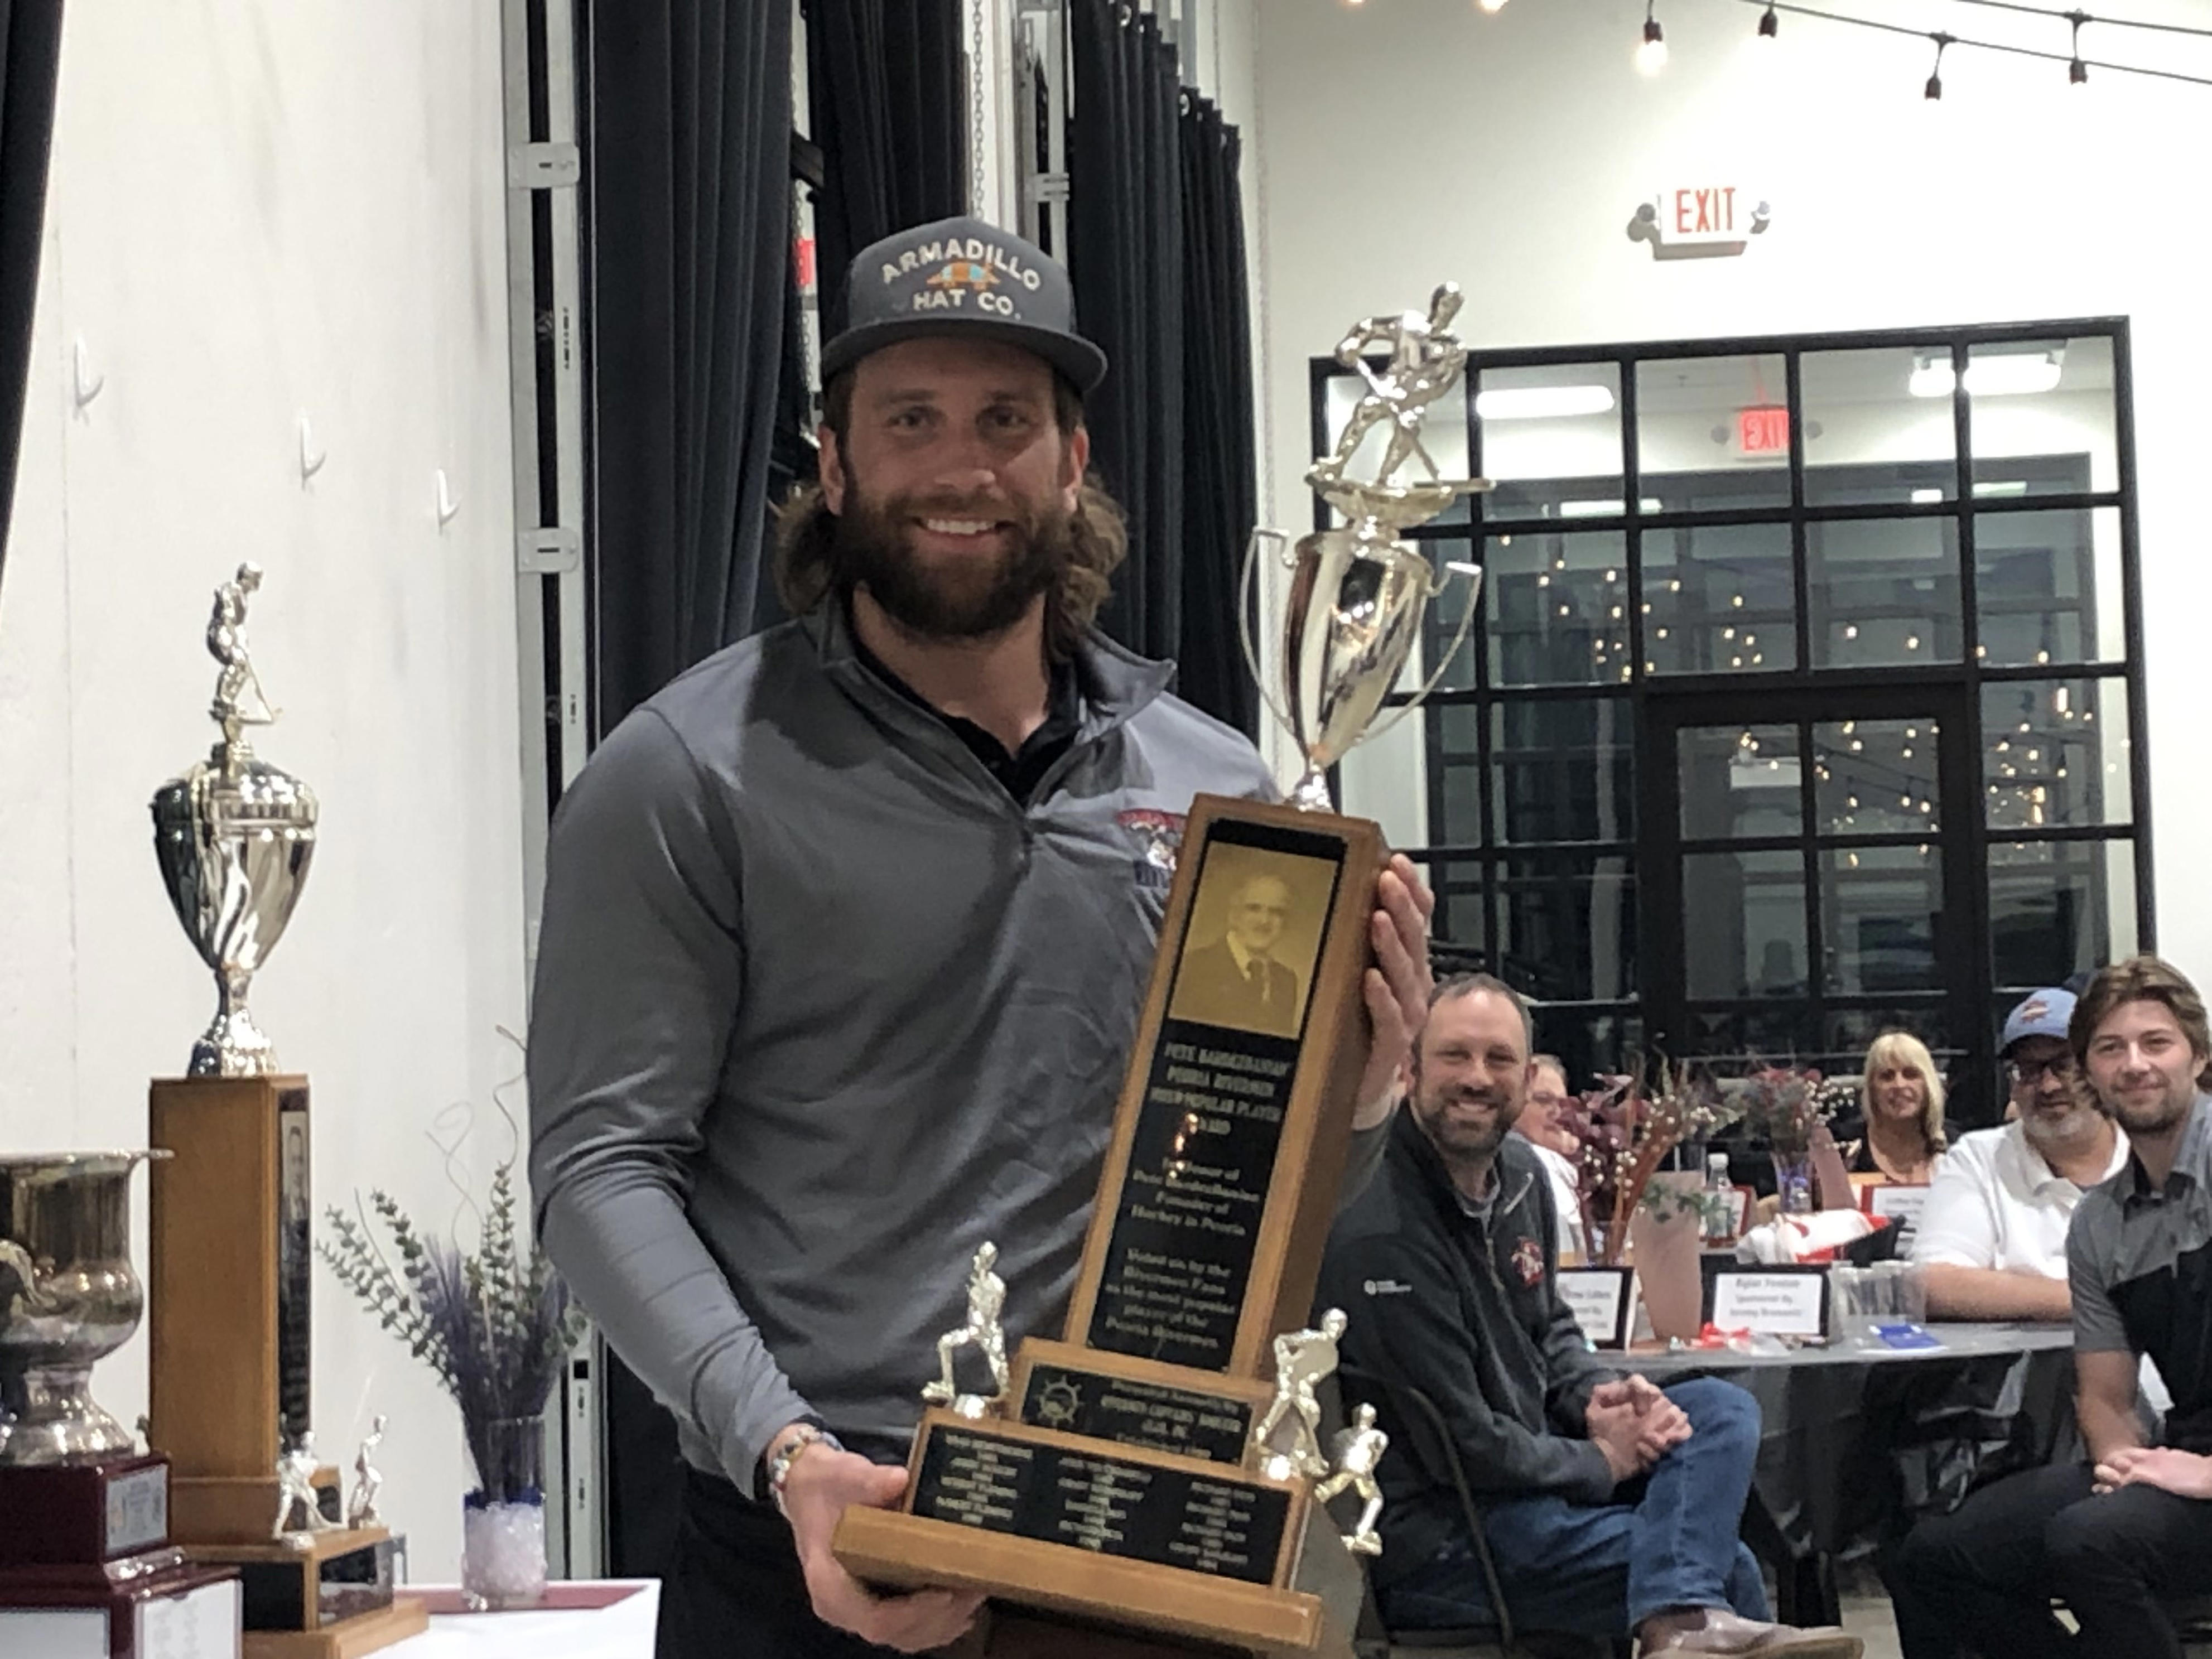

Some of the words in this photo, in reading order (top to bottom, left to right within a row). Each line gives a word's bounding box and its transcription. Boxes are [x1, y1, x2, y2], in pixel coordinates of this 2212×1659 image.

[1676, 187, 1736, 233] EXIT
[881, 238, 1041, 291] ARMADILLO
[913, 288, 966, 311] HAT
[977, 292, 1021, 320] CO.
